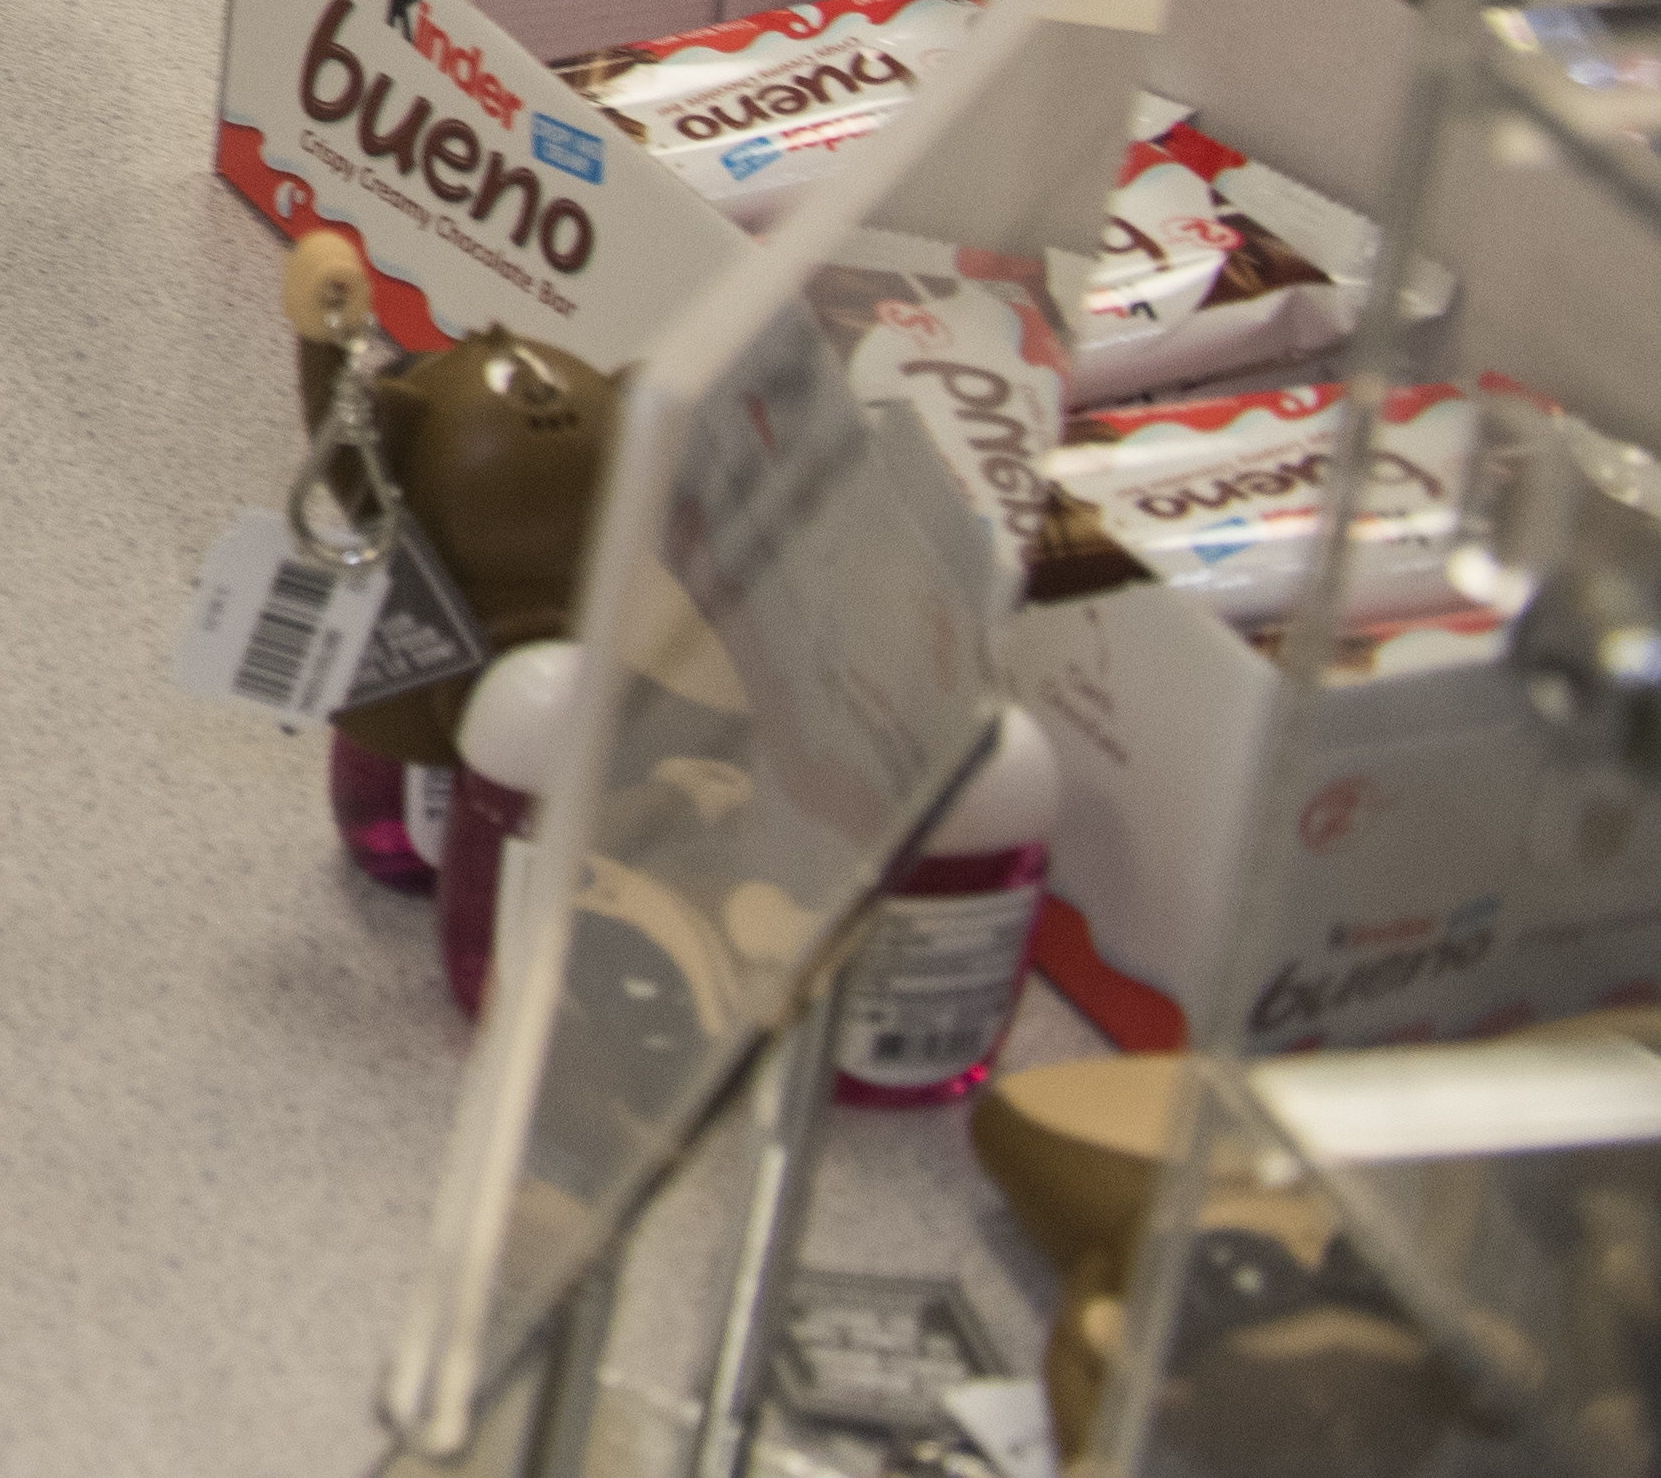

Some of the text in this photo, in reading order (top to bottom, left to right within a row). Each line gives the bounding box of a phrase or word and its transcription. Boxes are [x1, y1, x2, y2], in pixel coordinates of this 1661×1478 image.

[299, 128, 579, 319] Crispy Creamy Chocolate Bar
